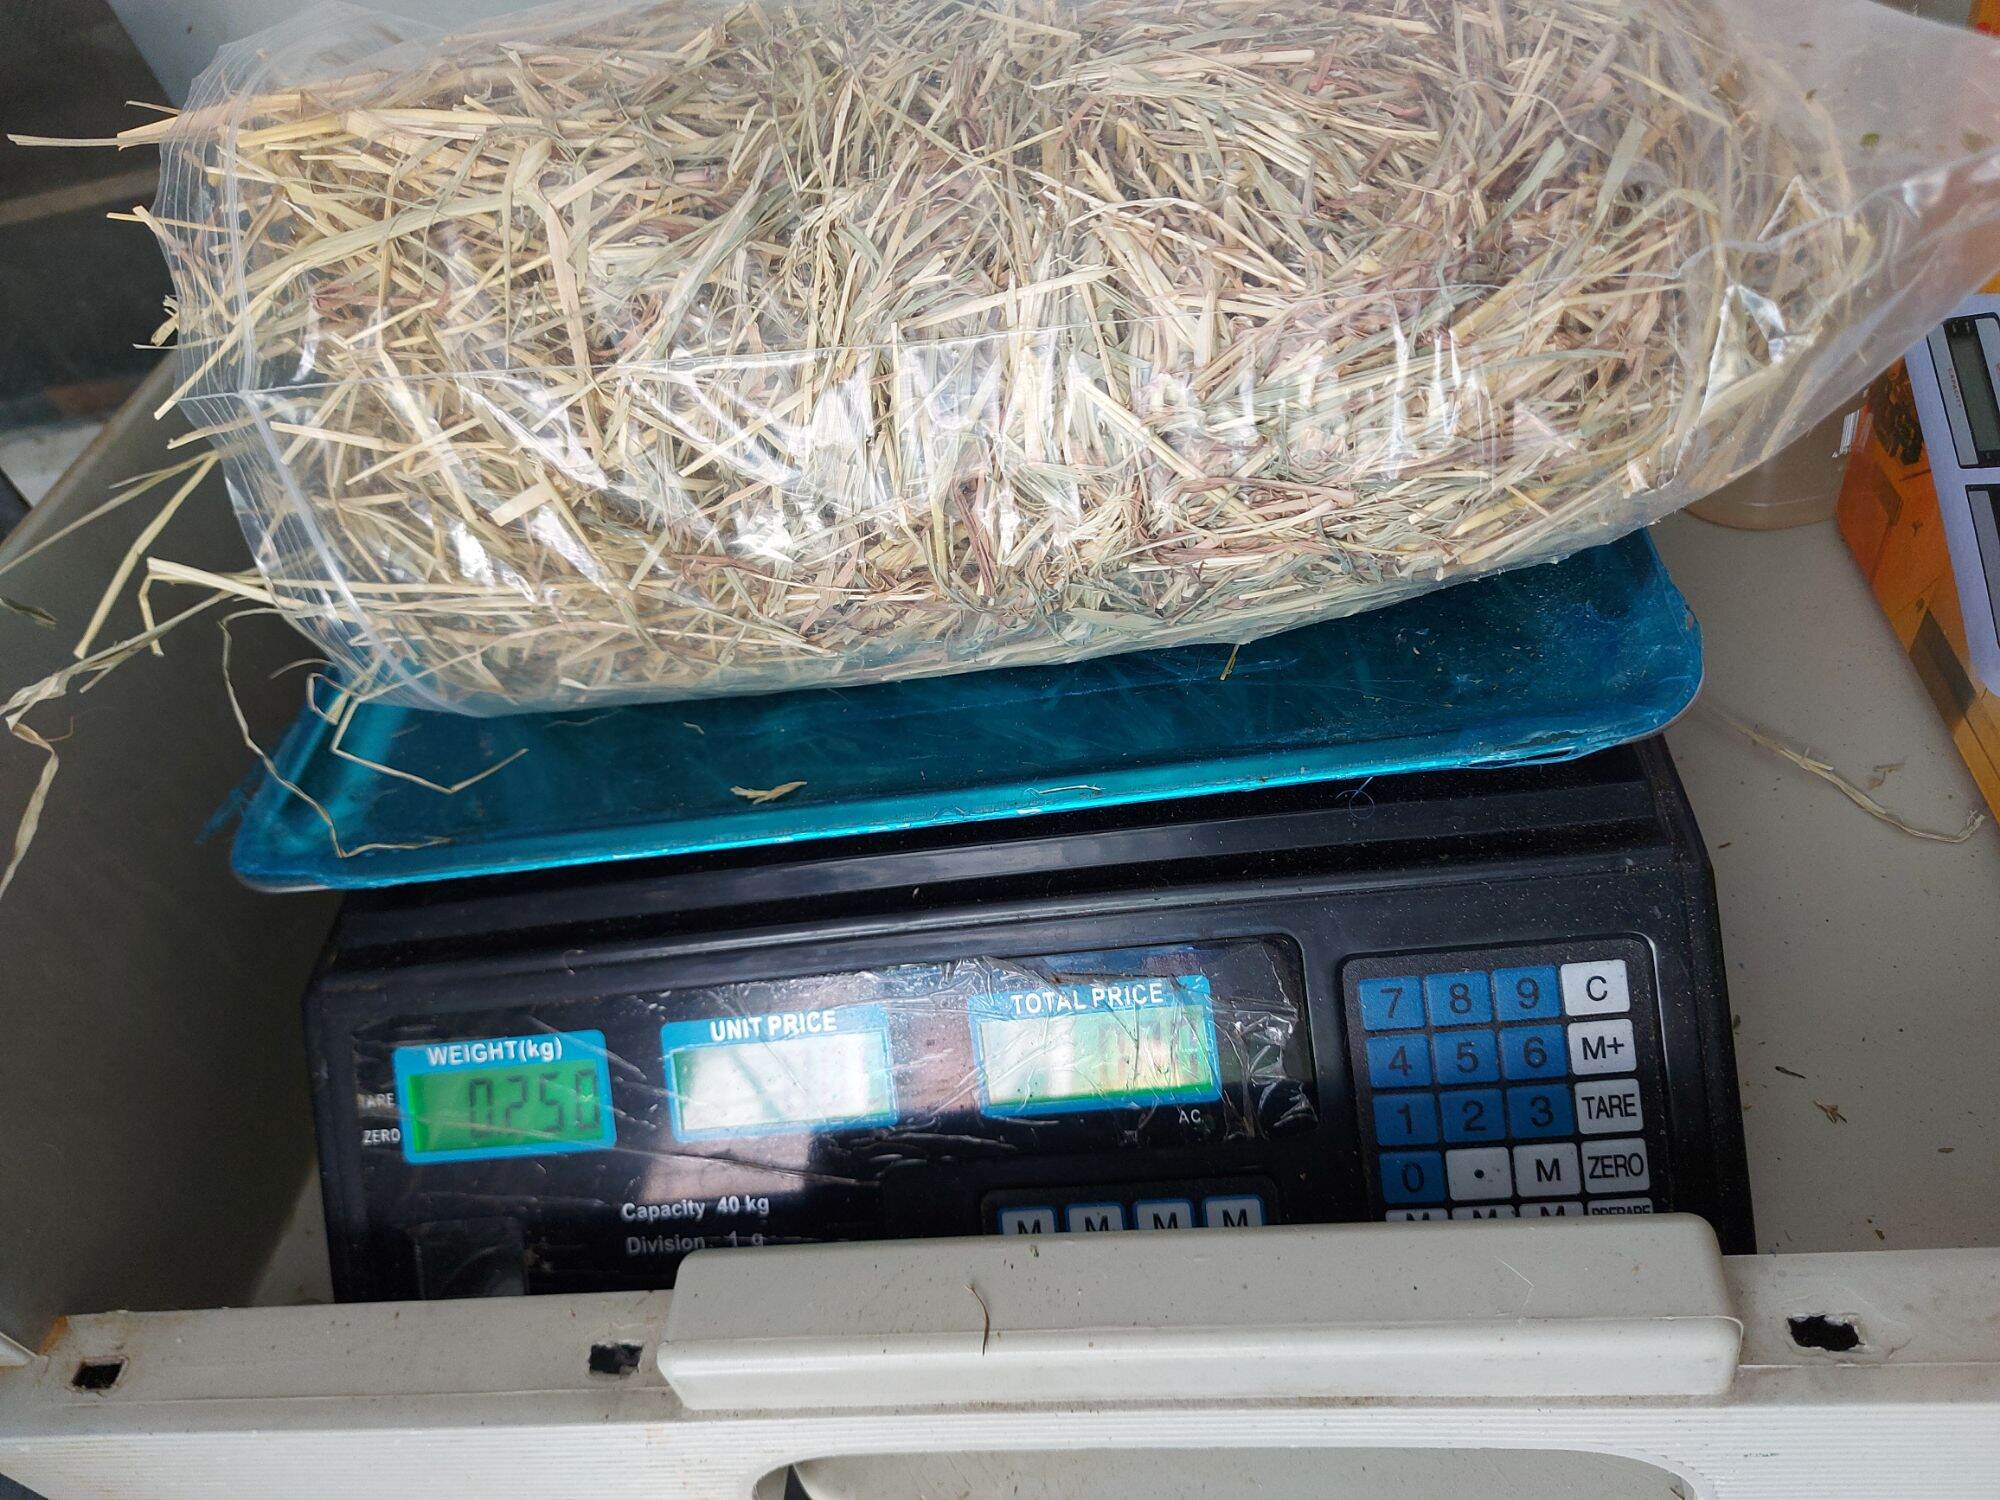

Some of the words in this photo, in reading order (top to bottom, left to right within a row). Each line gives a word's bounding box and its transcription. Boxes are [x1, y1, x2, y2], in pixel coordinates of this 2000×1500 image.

[1011, 991, 1086, 1016] TOTAL
[1091, 982, 1165, 1007] PRICE
[1380, 987, 1403, 1019] 7
[1449, 982, 1472, 1014] 8
[1516, 977, 1539, 1009] 9
[1585, 975, 1608, 1001] C
[709, 1017, 763, 1042] UNIT
[767, 1010, 837, 1037] PRICE
[426, 1037, 563, 1066] WEIGHT(kg)
[1388, 1046, 1412, 1076] 4
[1456, 1041, 1479, 1073] 5
[1523, 1036, 1547, 1068] 6
[1581, 1035, 1625, 1060] M+
[1178, 1108, 1201, 1125] AC
[1397, 1103, 1413, 1134] 1
[1461, 1100, 1487, 1132] 2
[1530, 1096, 1554, 1128] 3
[1581, 1093, 1637, 1119] TARE
[361, 1128, 401, 1146] ZERO
[1401, 1163, 1425, 1193] 0
[1536, 1158, 1561, 1182] M
[1587, 1153, 1644, 1179] ZERO
[621, 1200, 706, 1222] Capacity
[715, 1195, 740, 1213] 40
[745, 1195, 770, 1214] kg
[1222, 1208, 1248, 1227] M
[626, 1234, 706, 1256] Division
